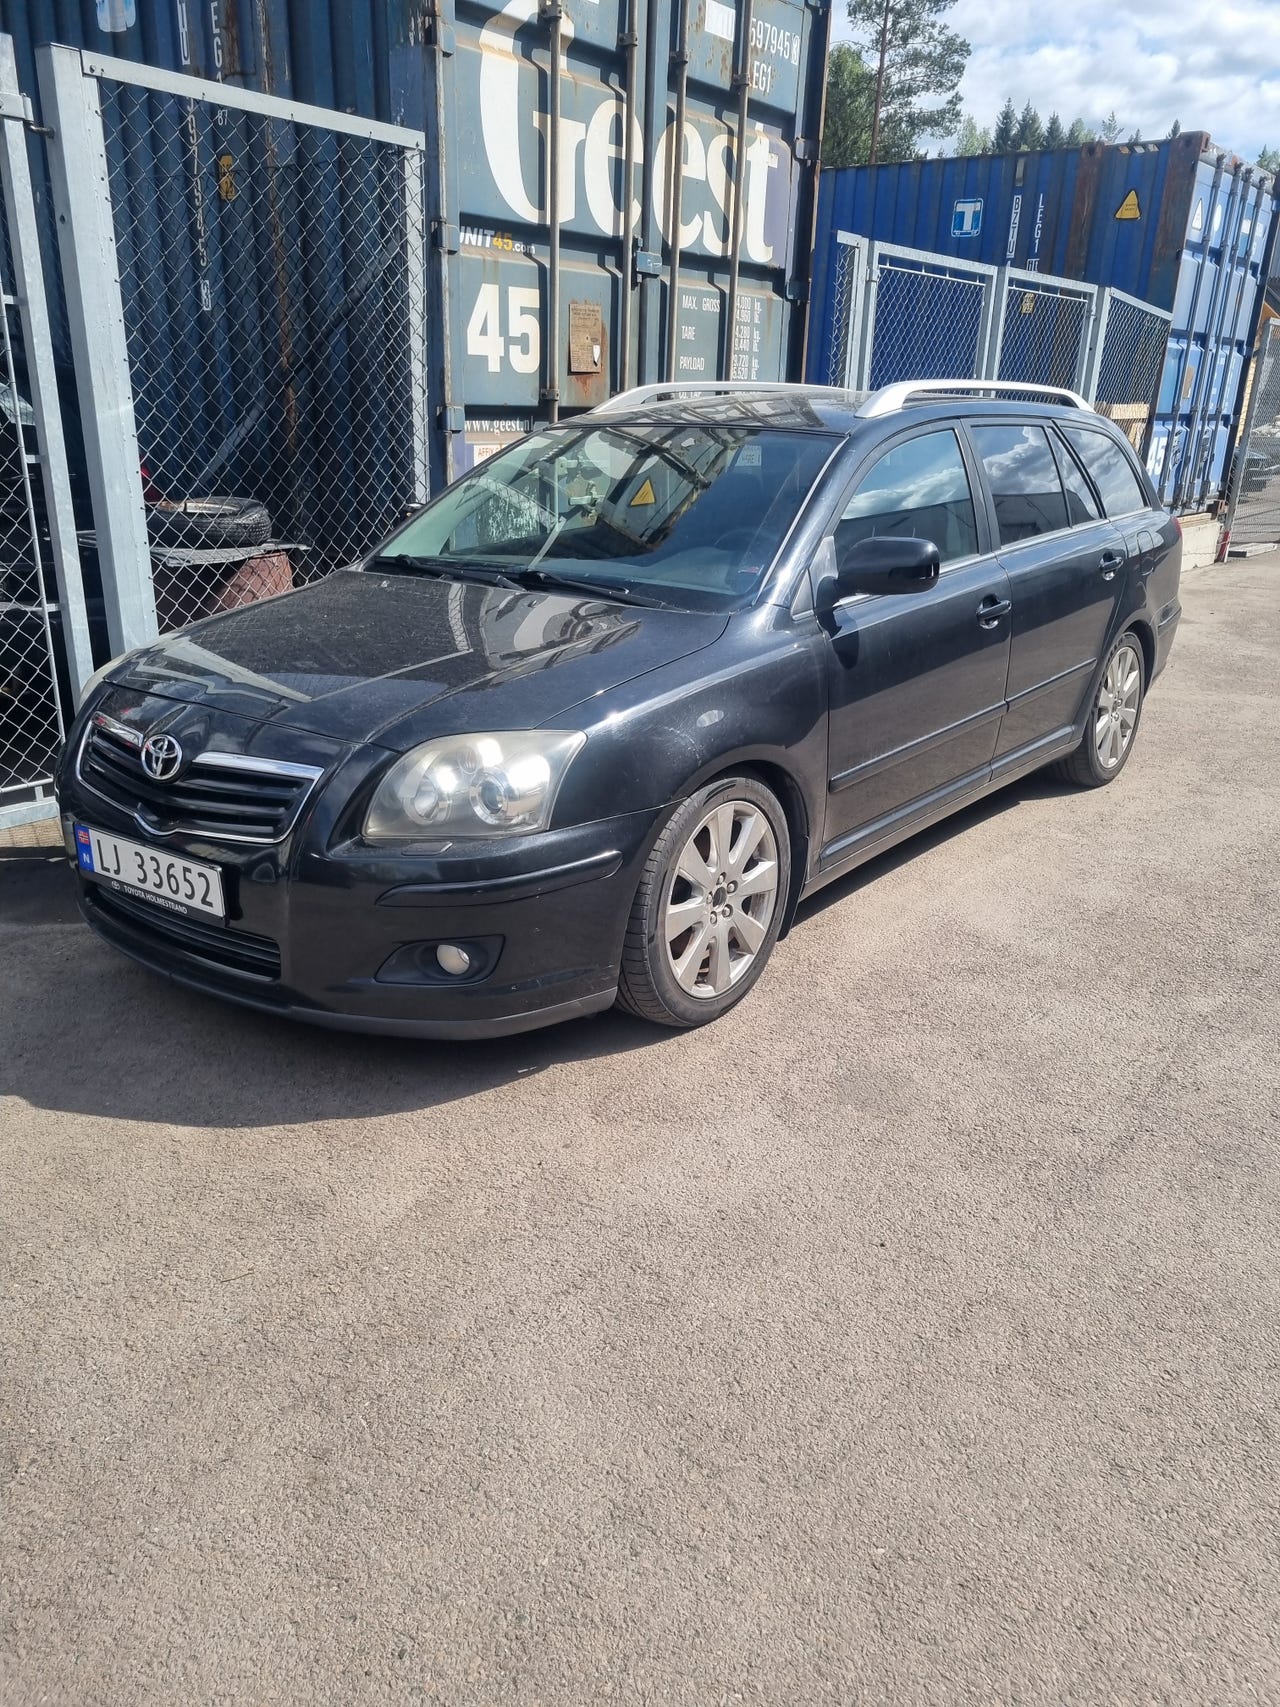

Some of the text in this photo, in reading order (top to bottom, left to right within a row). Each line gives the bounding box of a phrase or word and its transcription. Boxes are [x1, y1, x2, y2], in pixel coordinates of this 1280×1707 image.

[748, 60, 771, 93] EG1
[479, 0, 778, 263] Geest
[1007, 195, 1021, 258] BZTU
[1034, 193, 1044, 254] LEG1
[682, 295, 698, 310] MAX.
[702, 297, 720, 313] GROSS
[467, 283, 540, 374] 45
[682, 326, 695, 341] TARE
[679, 356, 705, 371] PAYLOAD
[464, 415, 534, 436] www.geest.nl
[82, 853, 91, 863] N
[96, 839, 214, 908] LJ 33652
[123, 885, 188, 915] TOYOTA HOLMESTRAND
